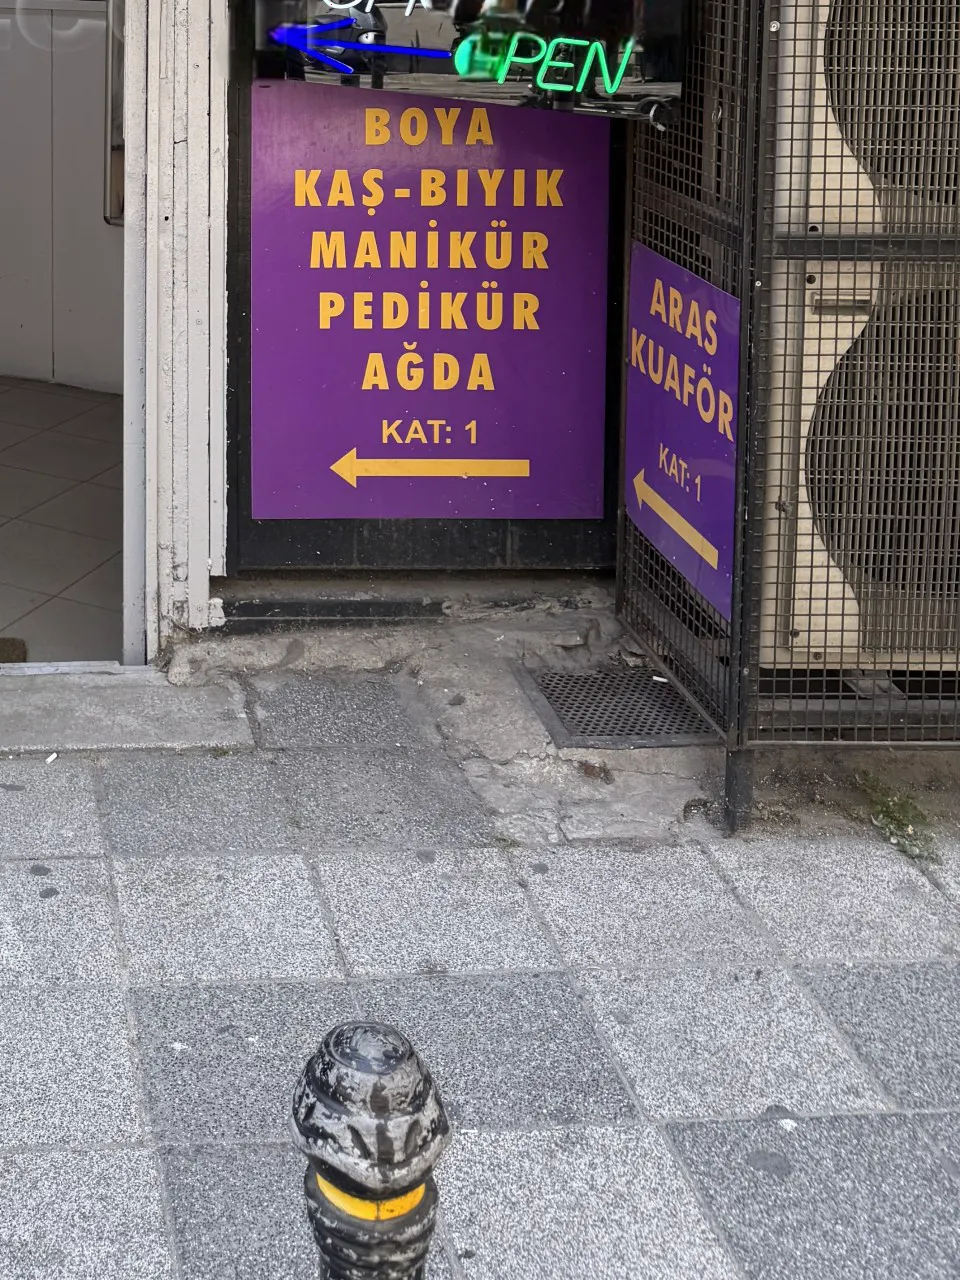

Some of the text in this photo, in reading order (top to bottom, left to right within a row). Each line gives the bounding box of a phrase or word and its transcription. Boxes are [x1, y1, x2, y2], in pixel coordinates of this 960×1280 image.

[363, 106, 495, 147] BOYA
[293, 168, 565, 217] KAŞ-BIYIK
[309, 219, 550, 270] MANİKÜR
[318, 280, 542, 331] PEDİKÜR
[648, 277, 719, 357] ARAS
[360, 341, 496, 392] AĞDA
[630, 327, 736, 443] KUAFÖR
[381, 419, 478, 445] KAT: 1
[658, 442, 702, 503] KAT: 1
